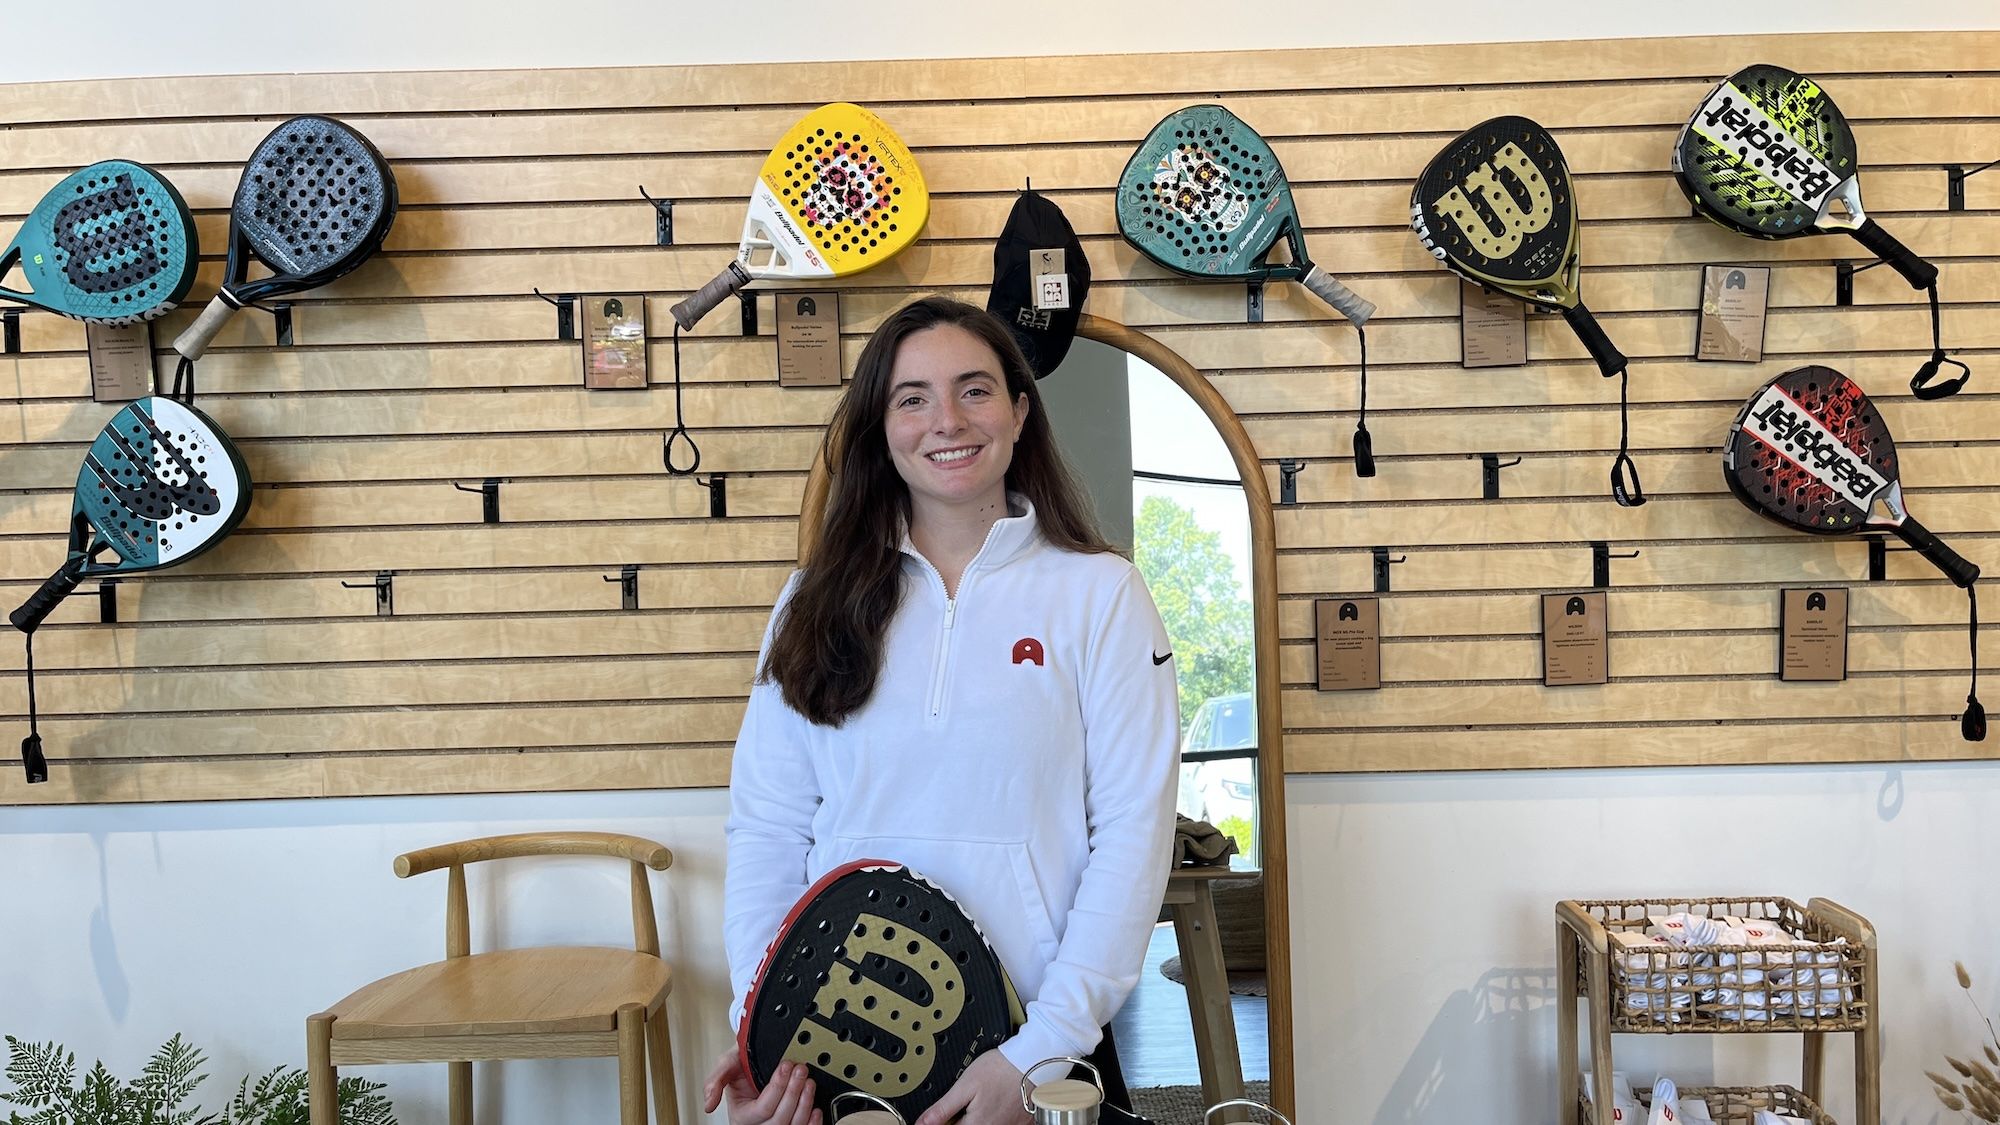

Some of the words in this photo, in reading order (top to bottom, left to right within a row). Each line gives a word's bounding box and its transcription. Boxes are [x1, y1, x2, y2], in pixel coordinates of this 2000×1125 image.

[876, 137, 902, 171] VERTEX
[1703, 98, 1832, 199] Babolat
[775, 211, 805, 246] Bullpadel
[1239, 214, 1265, 251] Bullpadel
[1524, 241, 1552, 267] DEFY
[1752, 401, 1879, 500] Babolat
[100, 516, 142, 560] Bullpadel
